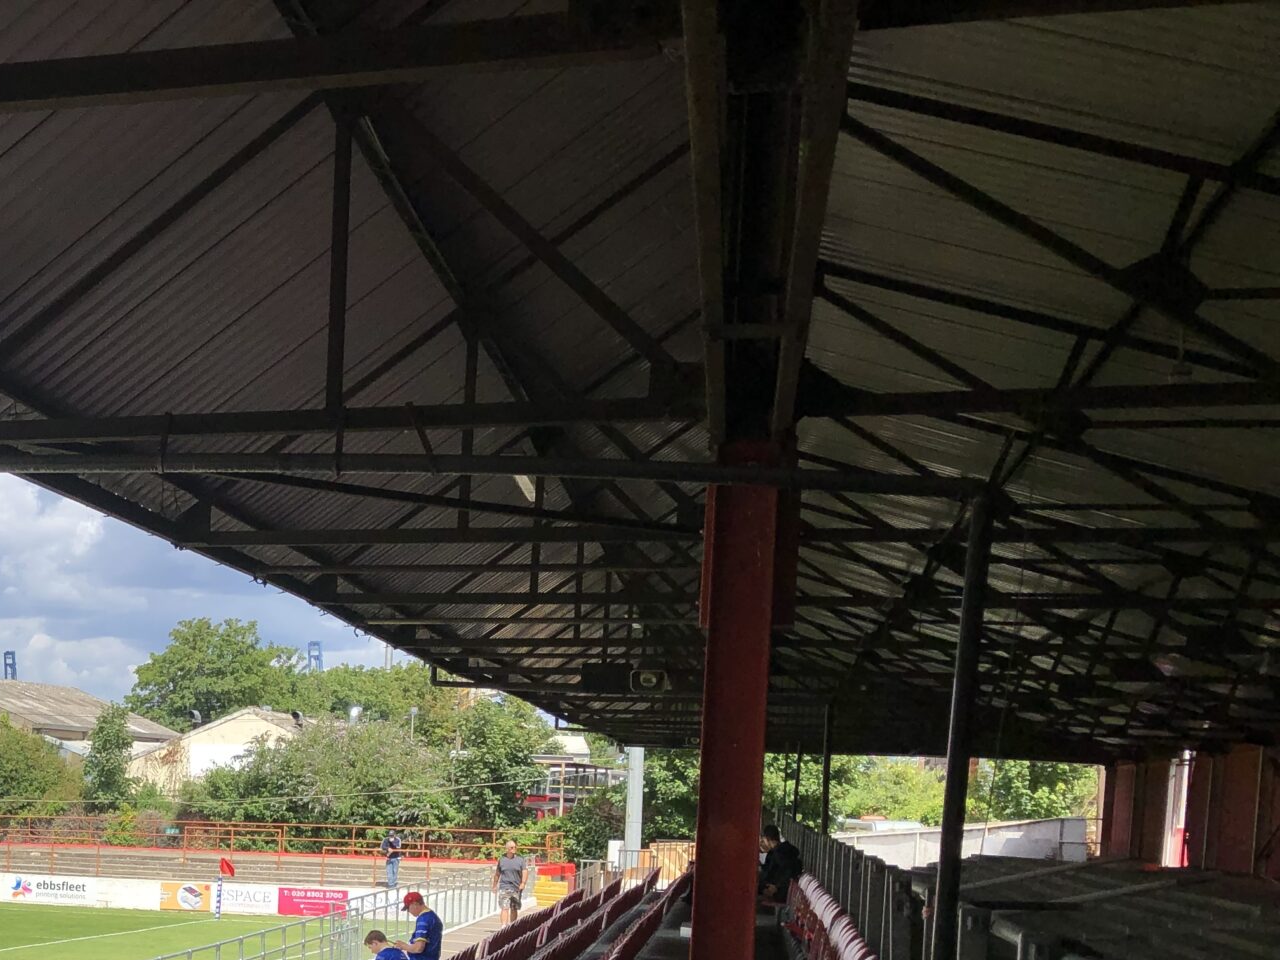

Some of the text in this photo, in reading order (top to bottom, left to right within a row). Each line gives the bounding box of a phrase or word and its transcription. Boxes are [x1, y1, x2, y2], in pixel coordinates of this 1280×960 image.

[36, 880, 86, 893] ebbsfleet
[35, 891, 86, 901] printing solutions
